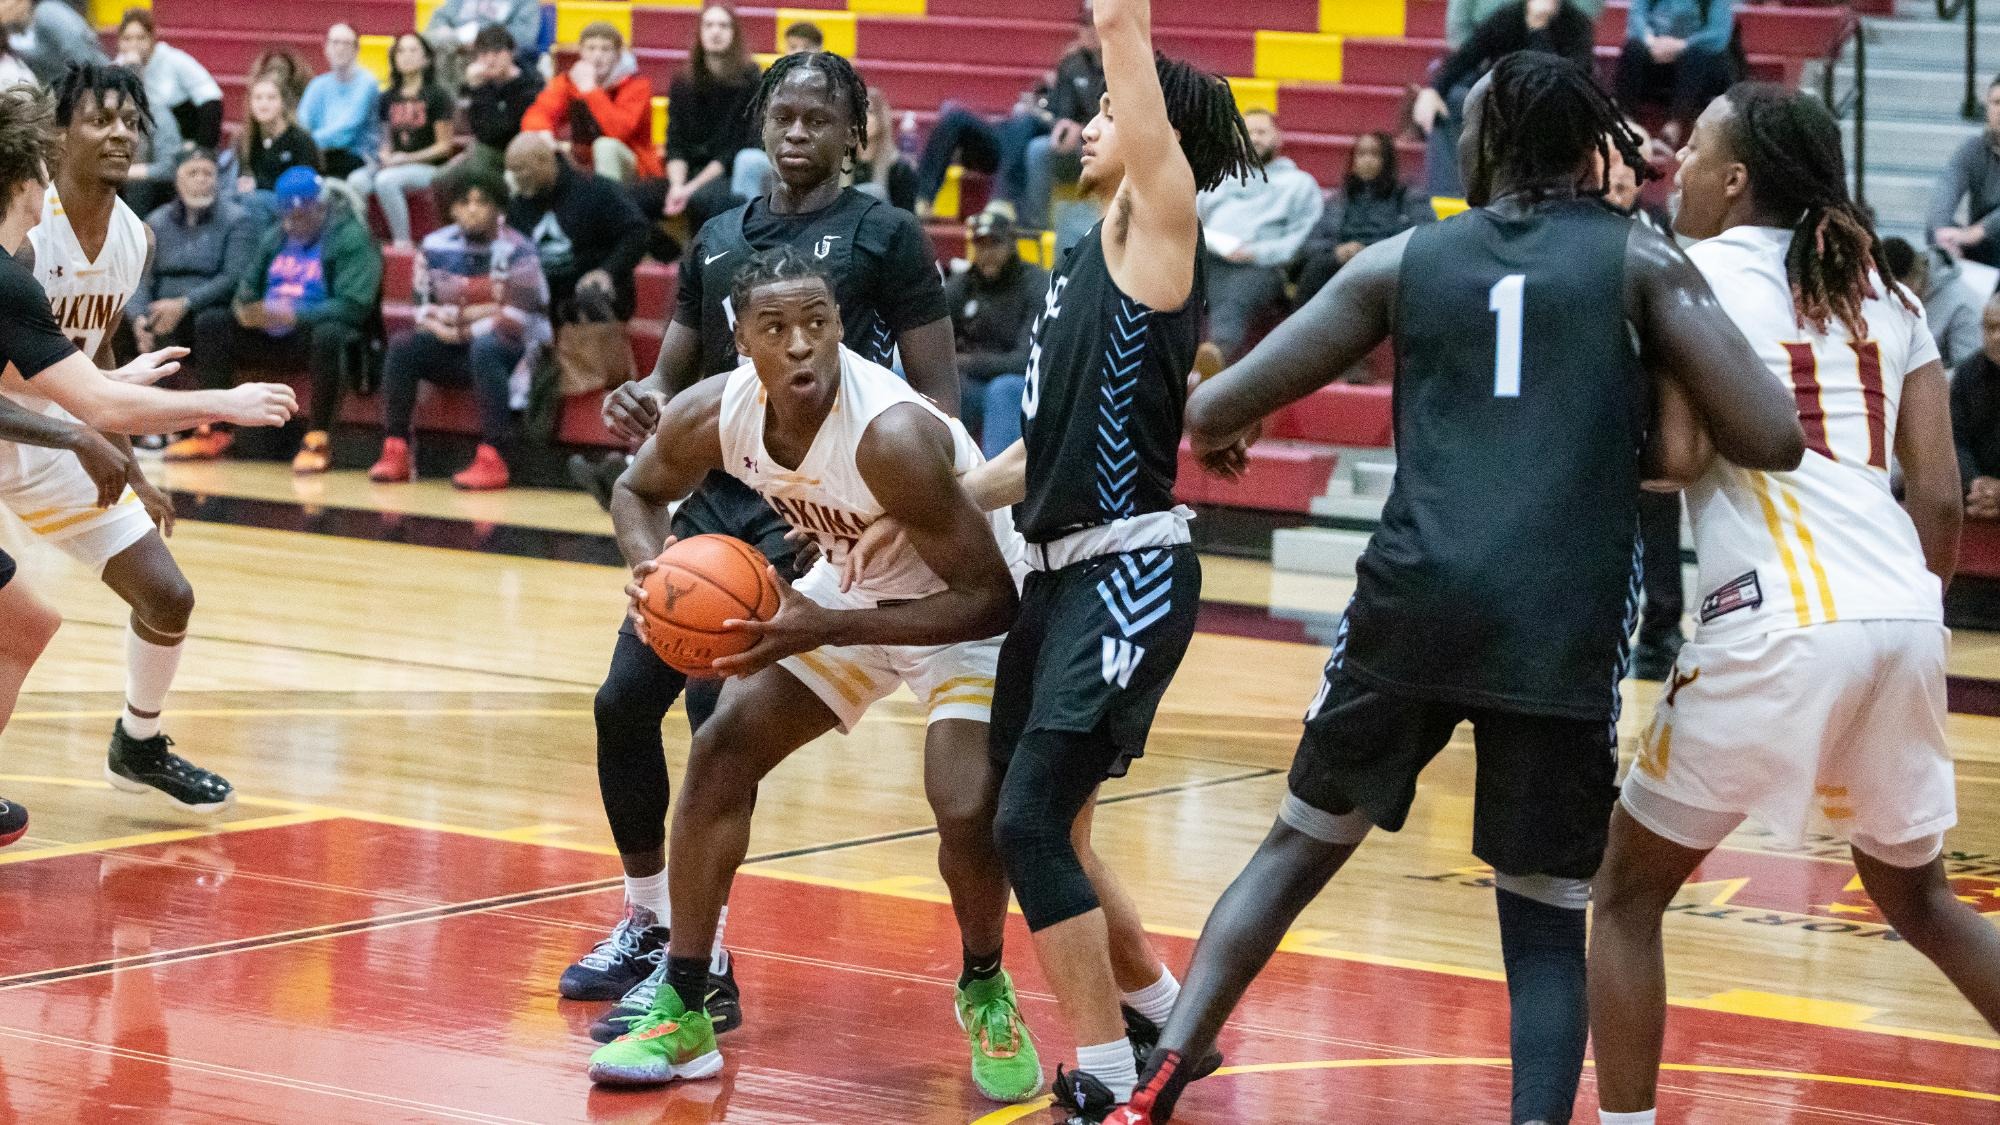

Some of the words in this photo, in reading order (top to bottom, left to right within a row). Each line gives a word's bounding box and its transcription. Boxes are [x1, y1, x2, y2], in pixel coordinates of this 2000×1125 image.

[1489, 273, 1526, 398] 1
[1778, 340, 1888, 472] 11
[1101, 634, 1146, 690] W
